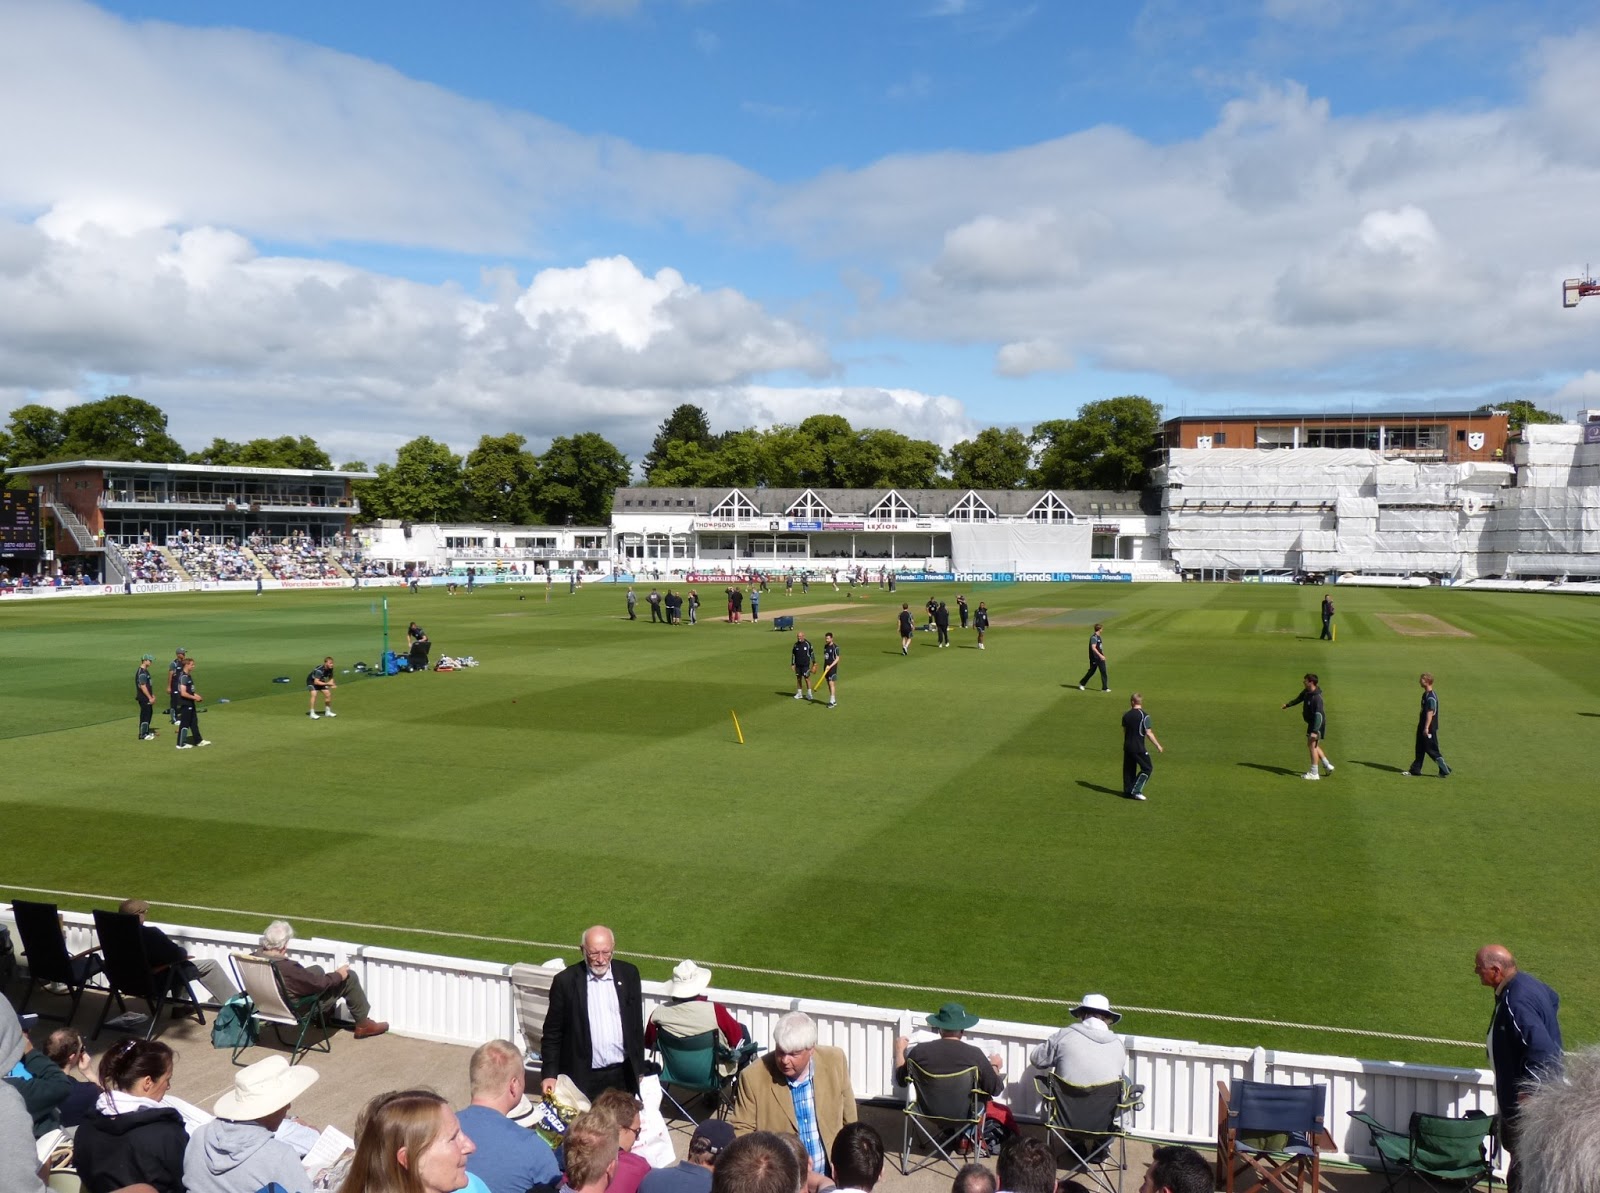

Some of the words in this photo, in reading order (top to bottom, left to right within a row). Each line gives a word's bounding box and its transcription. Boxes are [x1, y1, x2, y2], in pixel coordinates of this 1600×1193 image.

[867, 522, 898, 530] LEXION
[954, 572, 1011, 582] FriendsLife
[1014, 572, 1070, 582] FriendsLife
[135, 583, 177, 593] COMPUTER
